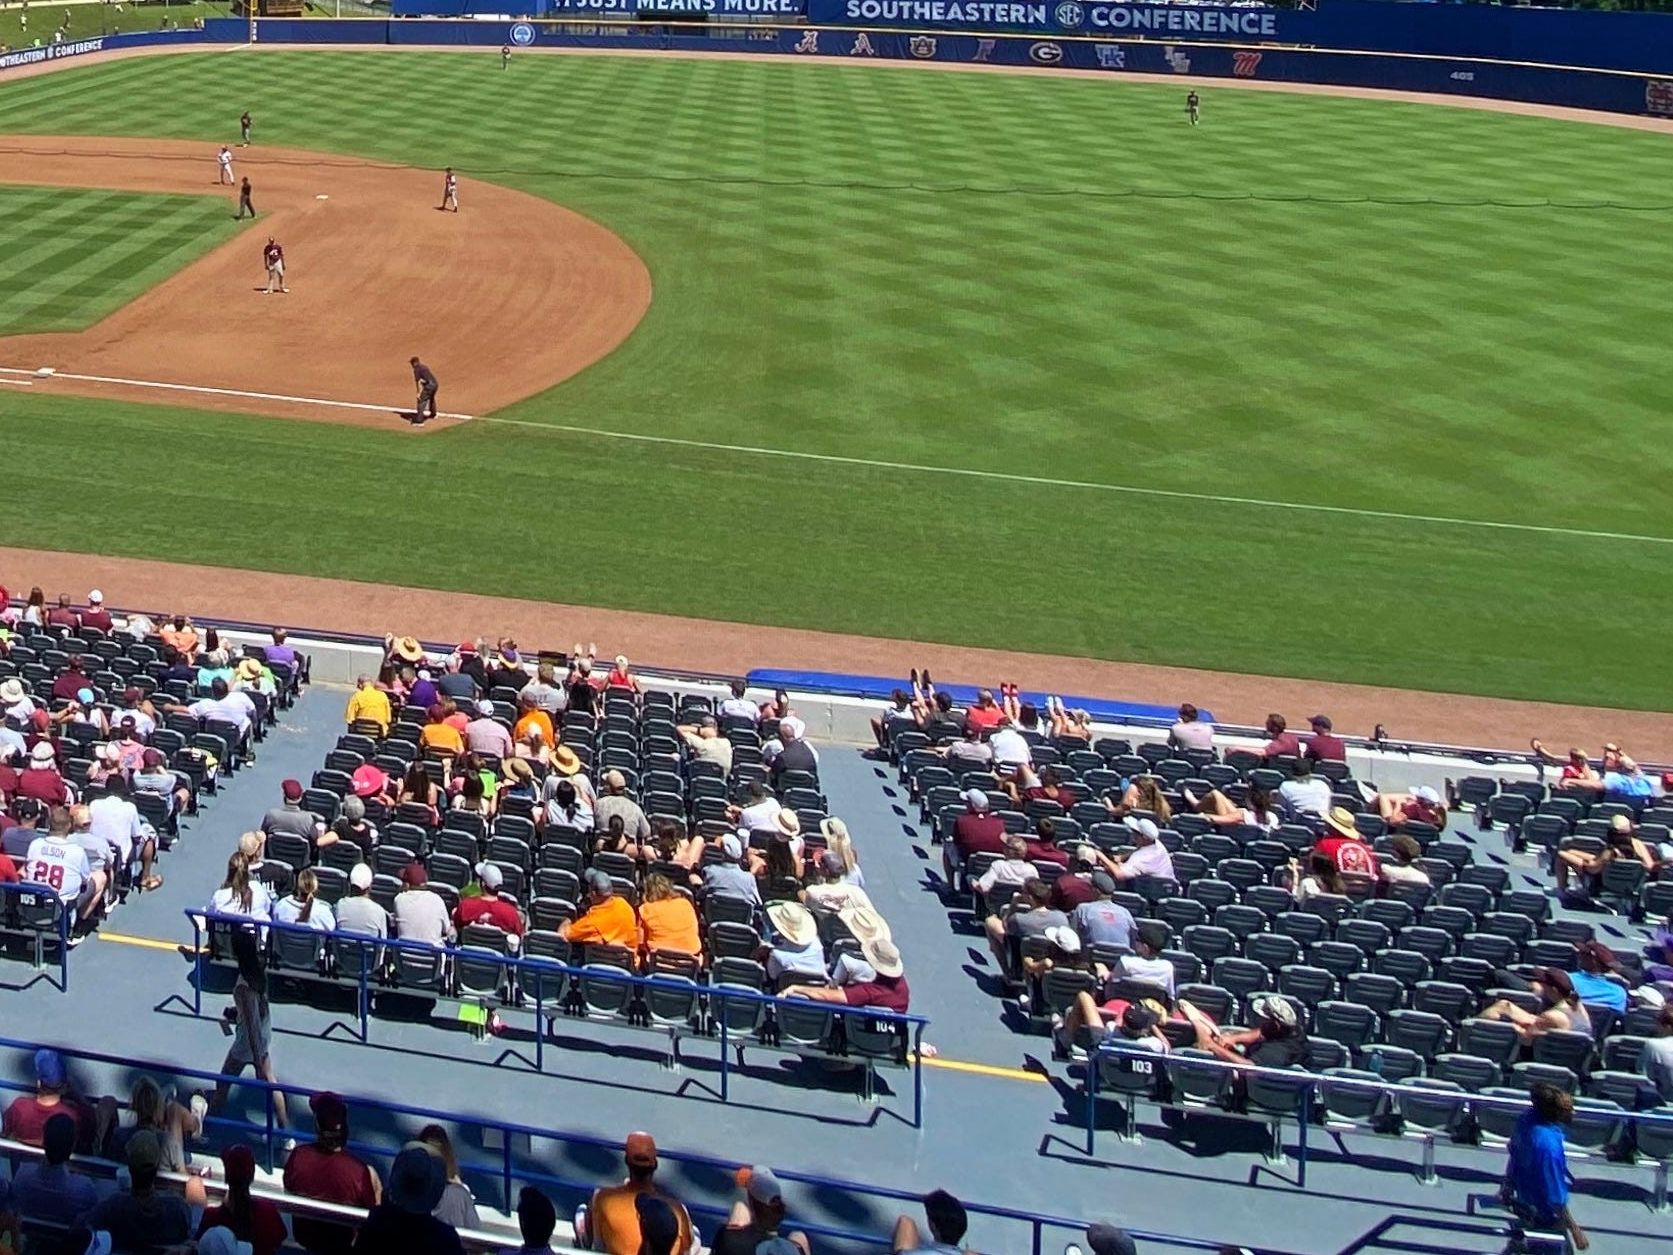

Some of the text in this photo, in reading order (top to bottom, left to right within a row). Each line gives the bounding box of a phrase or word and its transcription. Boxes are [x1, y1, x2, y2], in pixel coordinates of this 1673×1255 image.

[847, 0, 1276, 34] SOUTHEASTERN SEC CONFERENCE
[55, 39, 104, 58] CONFERENCE
[34, 860, 65, 891] 28
[1131, 1059, 1153, 1074] 103
